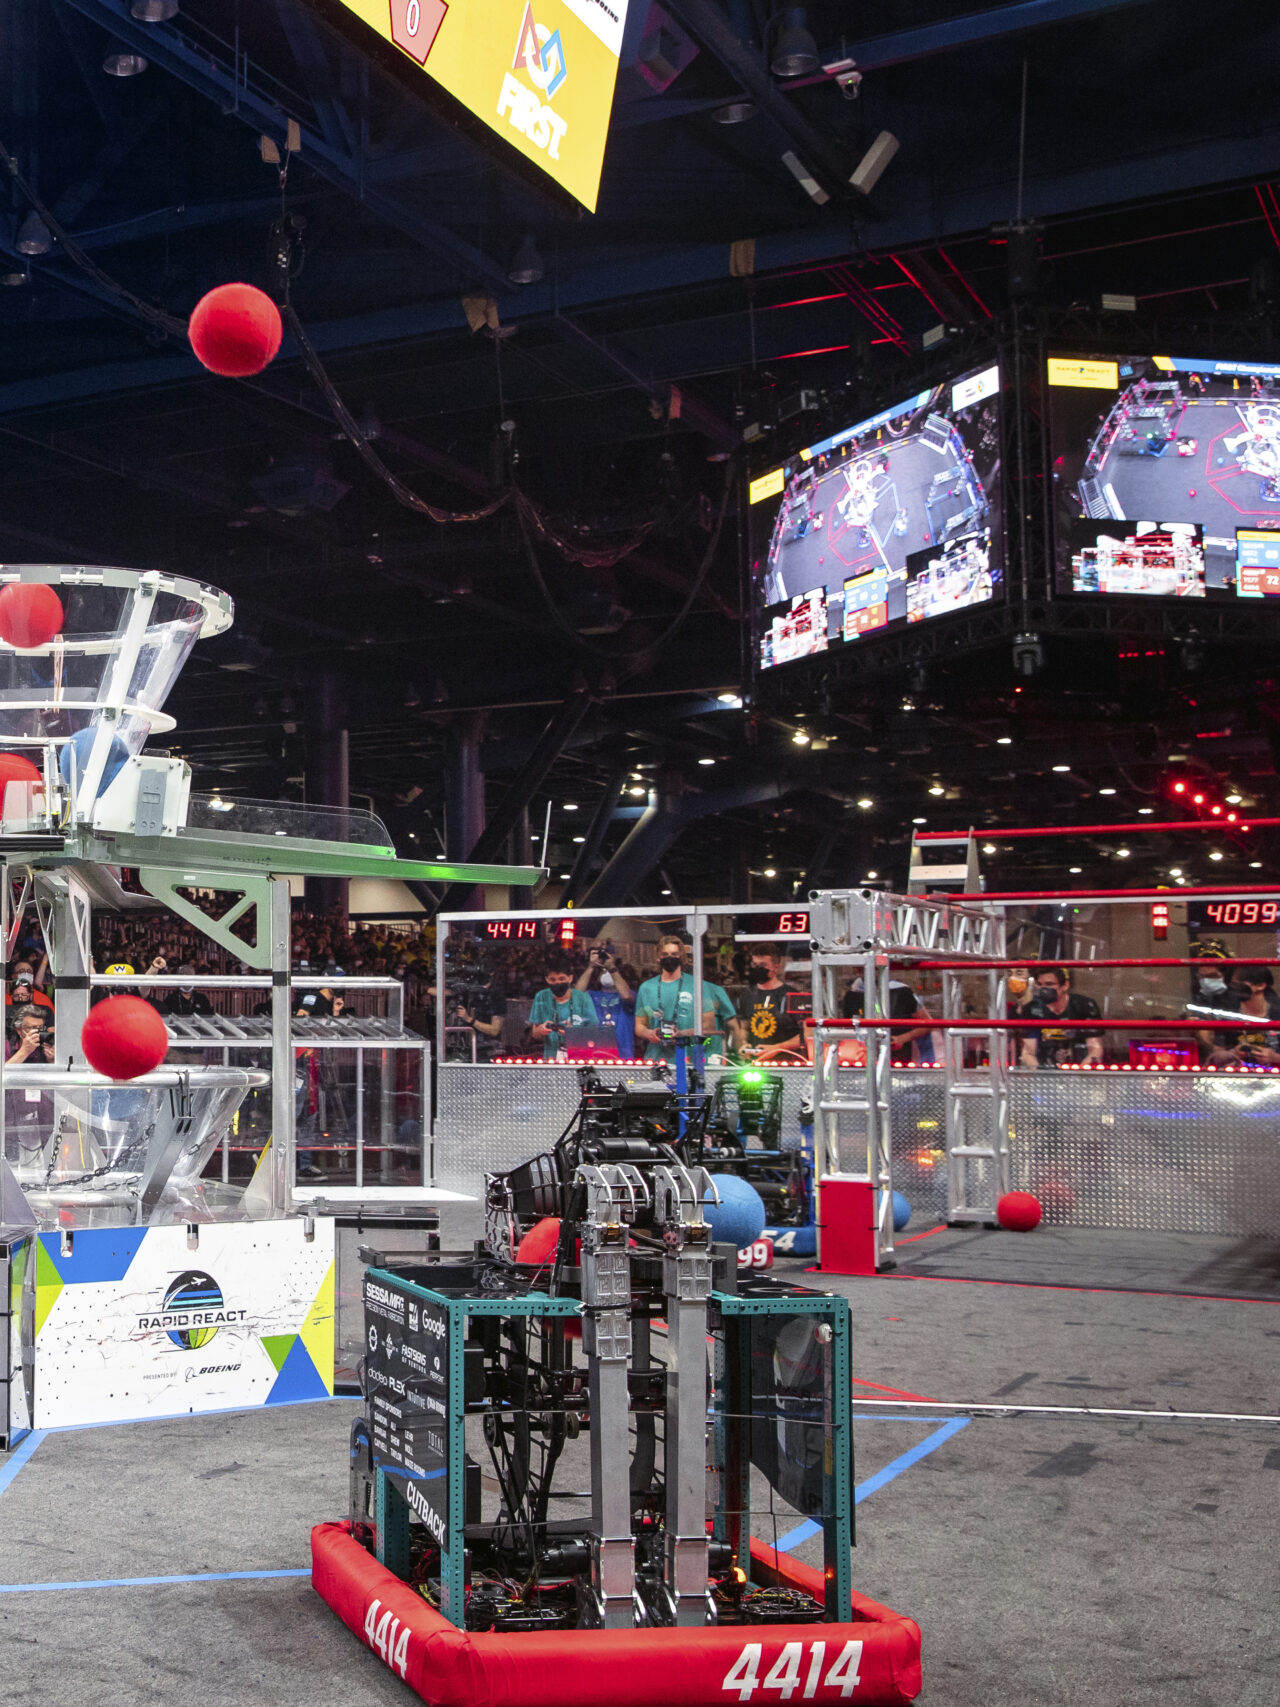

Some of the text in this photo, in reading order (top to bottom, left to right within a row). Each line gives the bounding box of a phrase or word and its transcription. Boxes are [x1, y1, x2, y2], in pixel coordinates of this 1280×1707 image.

[1207, 903, 1278, 924] 4099
[486, 922, 537, 939] 4414
[138, 1310, 247, 1329] RAPID REACT
[422, 1309, 446, 1340] Google
[143, 1371, 177, 1381] PRESENTED BY
[199, 1363, 242, 1375] BOEING
[406, 1480, 446, 1545] CUTBACK
[364, 1599, 412, 1680] 4414
[722, 1640, 864, 1701] 4414
